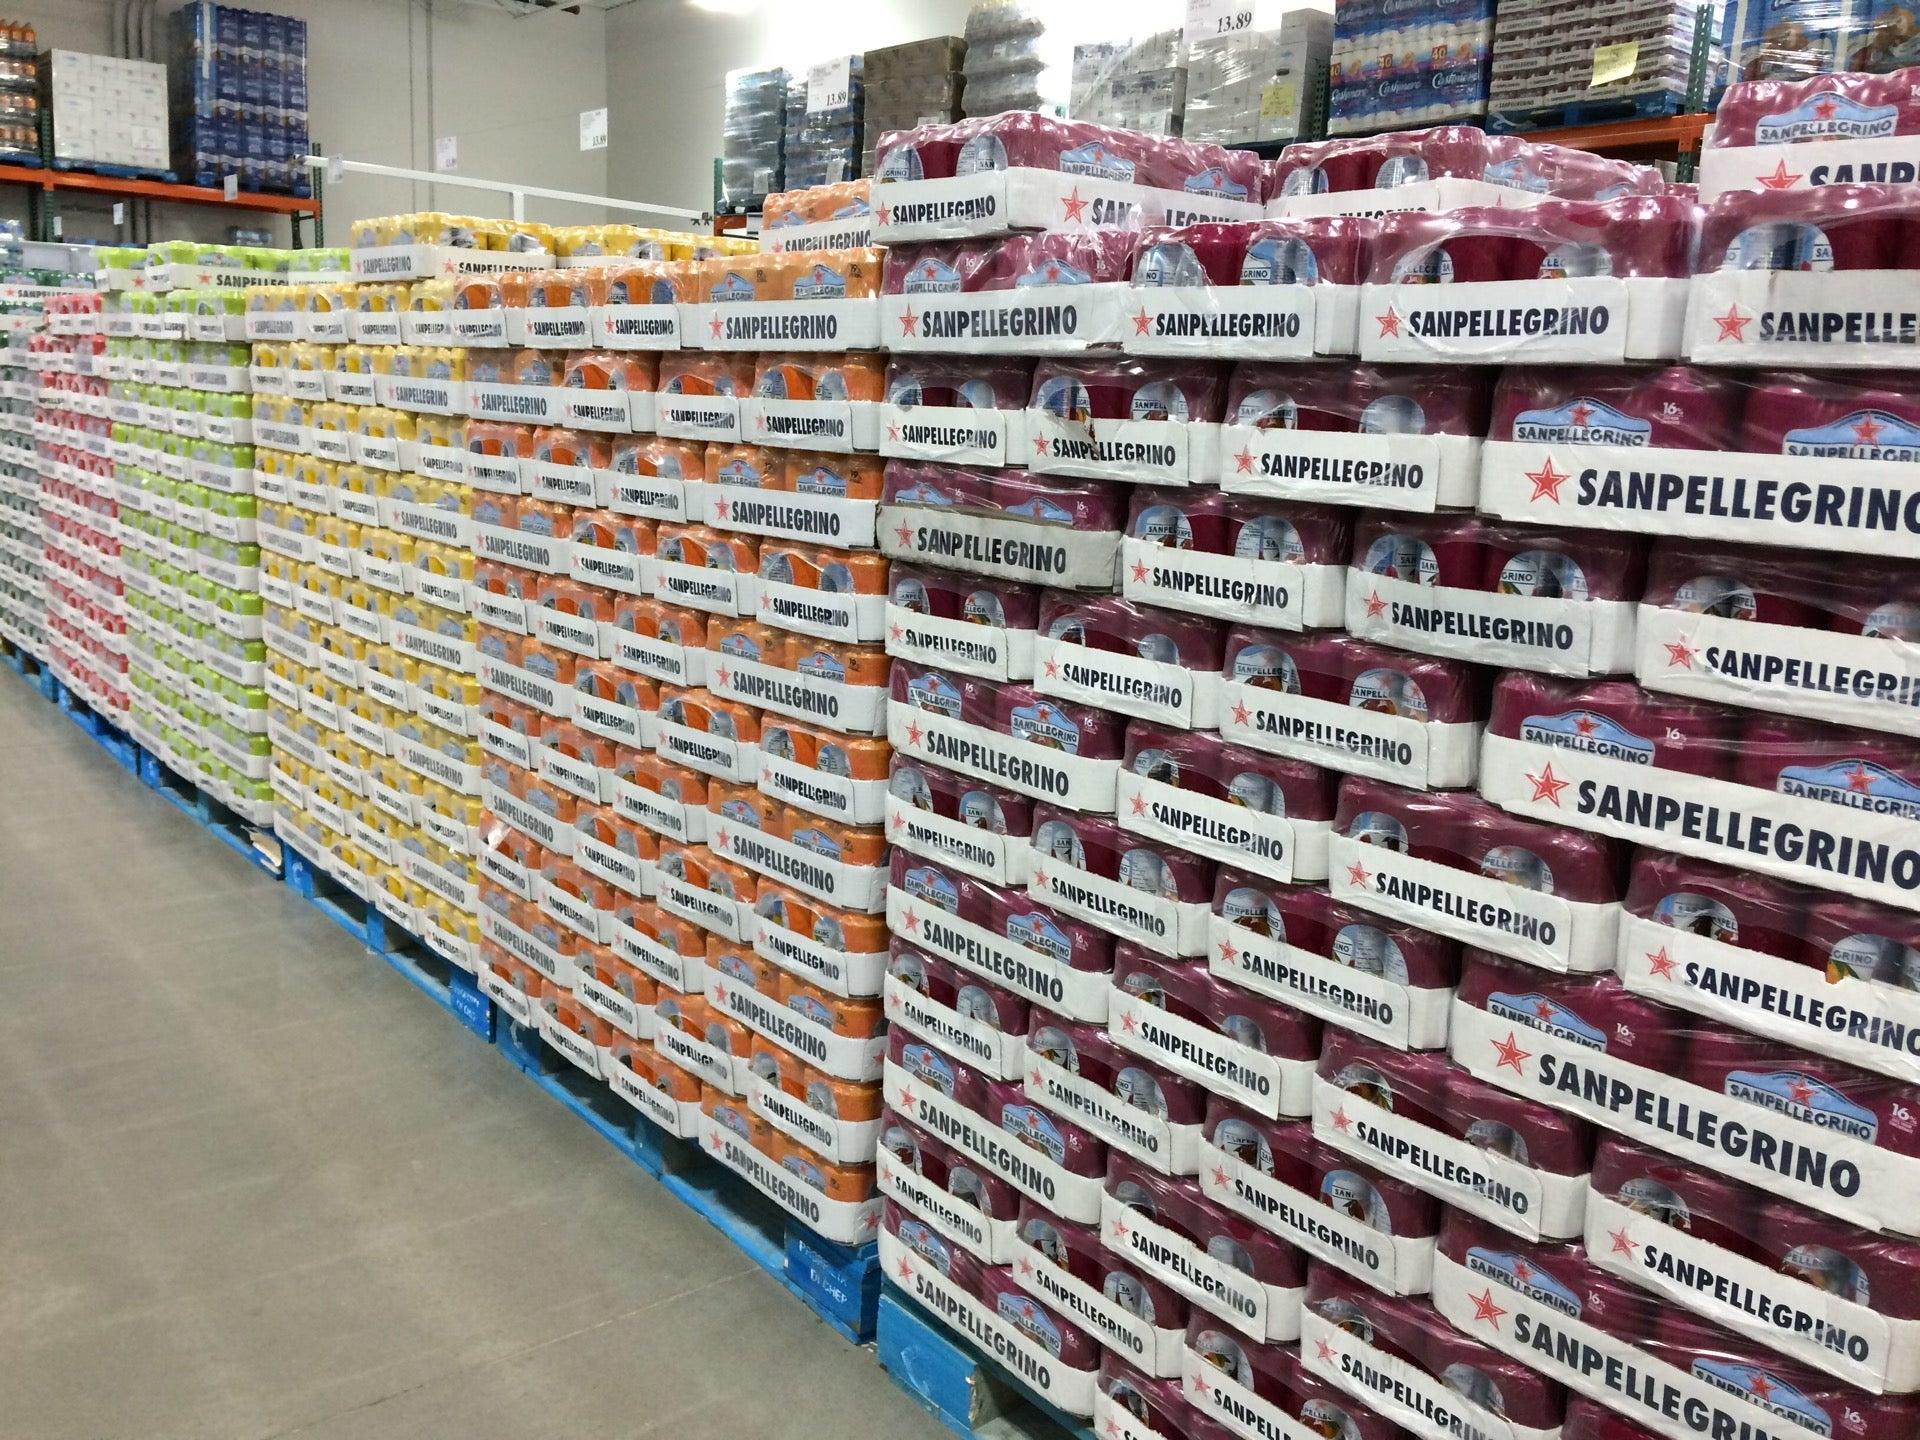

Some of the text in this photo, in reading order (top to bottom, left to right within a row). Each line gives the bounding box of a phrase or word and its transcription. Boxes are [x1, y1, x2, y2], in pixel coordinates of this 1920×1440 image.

[1216, 12, 1252, 34] 13.89
[1432, 46, 1447, 59] 40
[826, 92, 848, 106] 13.89
[1760, 120, 1892, 140] SANPELLEGRINO
[616, 320, 673, 335] SANPELLEGRINO
[727, 315, 837, 339] SANPELLEGRINO
[923, 305, 1076, 337] SANPELLEGRINO
[1156, 314, 1299, 337] SANPELLEGRINO
[1408, 306, 1609, 337] SANPELLEGRINO
[1760, 312, 1920, 344] SANPELLE
[396, 388, 447, 406] SANPELLEGRINO
[482, 394, 546, 416] SANPELLEGRINO
[767, 416, 843, 437] SANPELLEGRINO
[903, 425, 996, 449] SANPELLEGRINO
[1517, 424, 1646, 448] SANPELLEGRINO
[1053, 439, 1175, 466] SANPELLEGRINO
[1262, 453, 1423, 488] SANPELLEGRINO
[401, 512, 457, 538] SANPELLEGRINO
[732, 501, 840, 538] SANPELLEGRINO
[486, 536, 550, 566] SANPELLEGRINO
[918, 530, 1066, 574] SANPELLEGRINO
[1154, 567, 1288, 608] SANPELLEGRINO
[773, 598, 848, 627] SANPELLEGRINO
[1392, 602, 1573, 650] SANPELLEGRINO
[906, 629, 996, 664] SANPELLEGRINO
[491, 667, 553, 707] SANPELLEGRINO
[734, 671, 838, 717] SANPELLEGRINO
[1063, 664, 1181, 708] SANPELLEGRINO
[1014, 716, 1078, 744] SANPELLEGRINO
[1257, 711, 1411, 765] SANPELLEGRINO
[1525, 726, 1650, 765] SANPELLEGRINO
[927, 731, 1068, 796] SANPELLEGRINO
[494, 796, 553, 842] SANPELLEGRINO
[1153, 803, 1283, 860] SANPELLEGRINO
[1578, 780, 1920, 889] SANPELLEGRINO
[734, 836, 834, 893] SANPELLEGRINO
[908, 822, 995, 868] SANPELLEGRINO
[1052, 877, 1165, 936] SANPELLEGRINO
[1377, 873, 1555, 945] SANPELLEGRINO
[769, 935, 839, 980] SANPELLEGRINO
[923, 920, 1063, 1002] SANPELLEGRINO
[1010, 923, 1070, 958] SANPELLEGRINO
[1243, 952, 1392, 1024] SANPELLEGRINO
[731, 992, 826, 1061] SANPELLEGRINO
[904, 1002, 992, 1061] SANPELLEGRINO
[1142, 1022, 1269, 1095] SANPELLEGRINO
[764, 1094, 831, 1147] SANPELLEGRINO
[1049, 1080, 1158, 1152] SANPELLEGRINO
[1539, 1054, 1861, 1197] SANPELLEGRINO
[1730, 1083, 1873, 1141] SANPELLEGRINO
[920, 1100, 1055, 1200] SANPELLEGRINO
[1358, 1122, 1528, 1214] SANPELLEGRINO
[725, 1142, 819, 1222] SANPELLEGRINO
[896, 1176, 982, 1244] SANPELLEGRINO
[1235, 1179, 1379, 1270] SANPELLEGRINO
[1132, 1231, 1256, 1318] SANPELLEGRINO
[1469, 1256, 1578, 1318] SANPELLEGRINO
[1037, 1270, 1143, 1353] SANPELLEGRINO
[1645, 1246, 1868, 1361] SANPELLEGRINO
[916, 1274, 1050, 1389] SANPELLEGRINO
